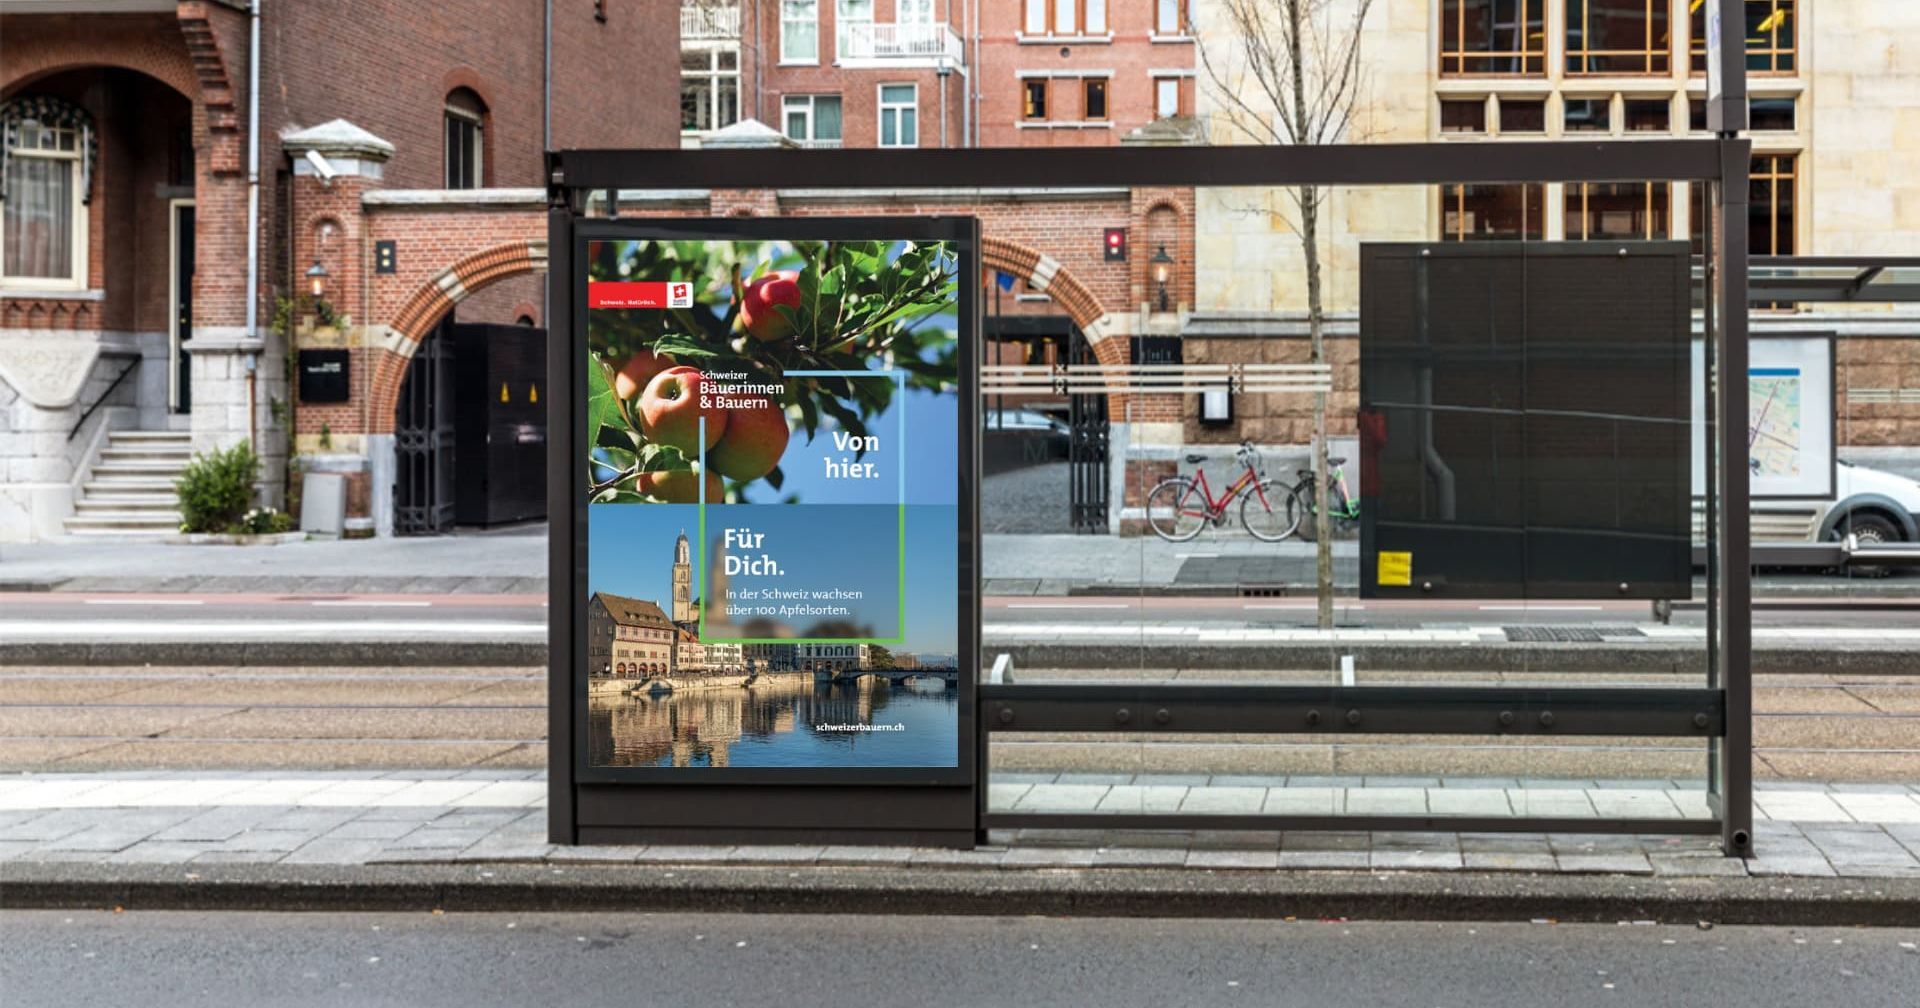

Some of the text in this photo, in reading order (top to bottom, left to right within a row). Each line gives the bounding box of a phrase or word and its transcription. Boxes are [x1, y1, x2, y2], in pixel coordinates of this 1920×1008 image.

[700, 370, 748, 380] Schweizer
[700, 381, 784, 394] Bäuerinnen
[700, 395, 768, 409] & Bauern
[832, 431, 879, 452] Von
[823, 456, 879, 479] hier.
[724, 528, 765, 549] Für
[724, 554, 785, 576] Dich.
[725, 588, 863, 600] In der Schweiz wachsen
[725, 604, 850, 618] über 100 Apfelsorten.
[816, 722, 905, 732] schweizerbauern.ch
